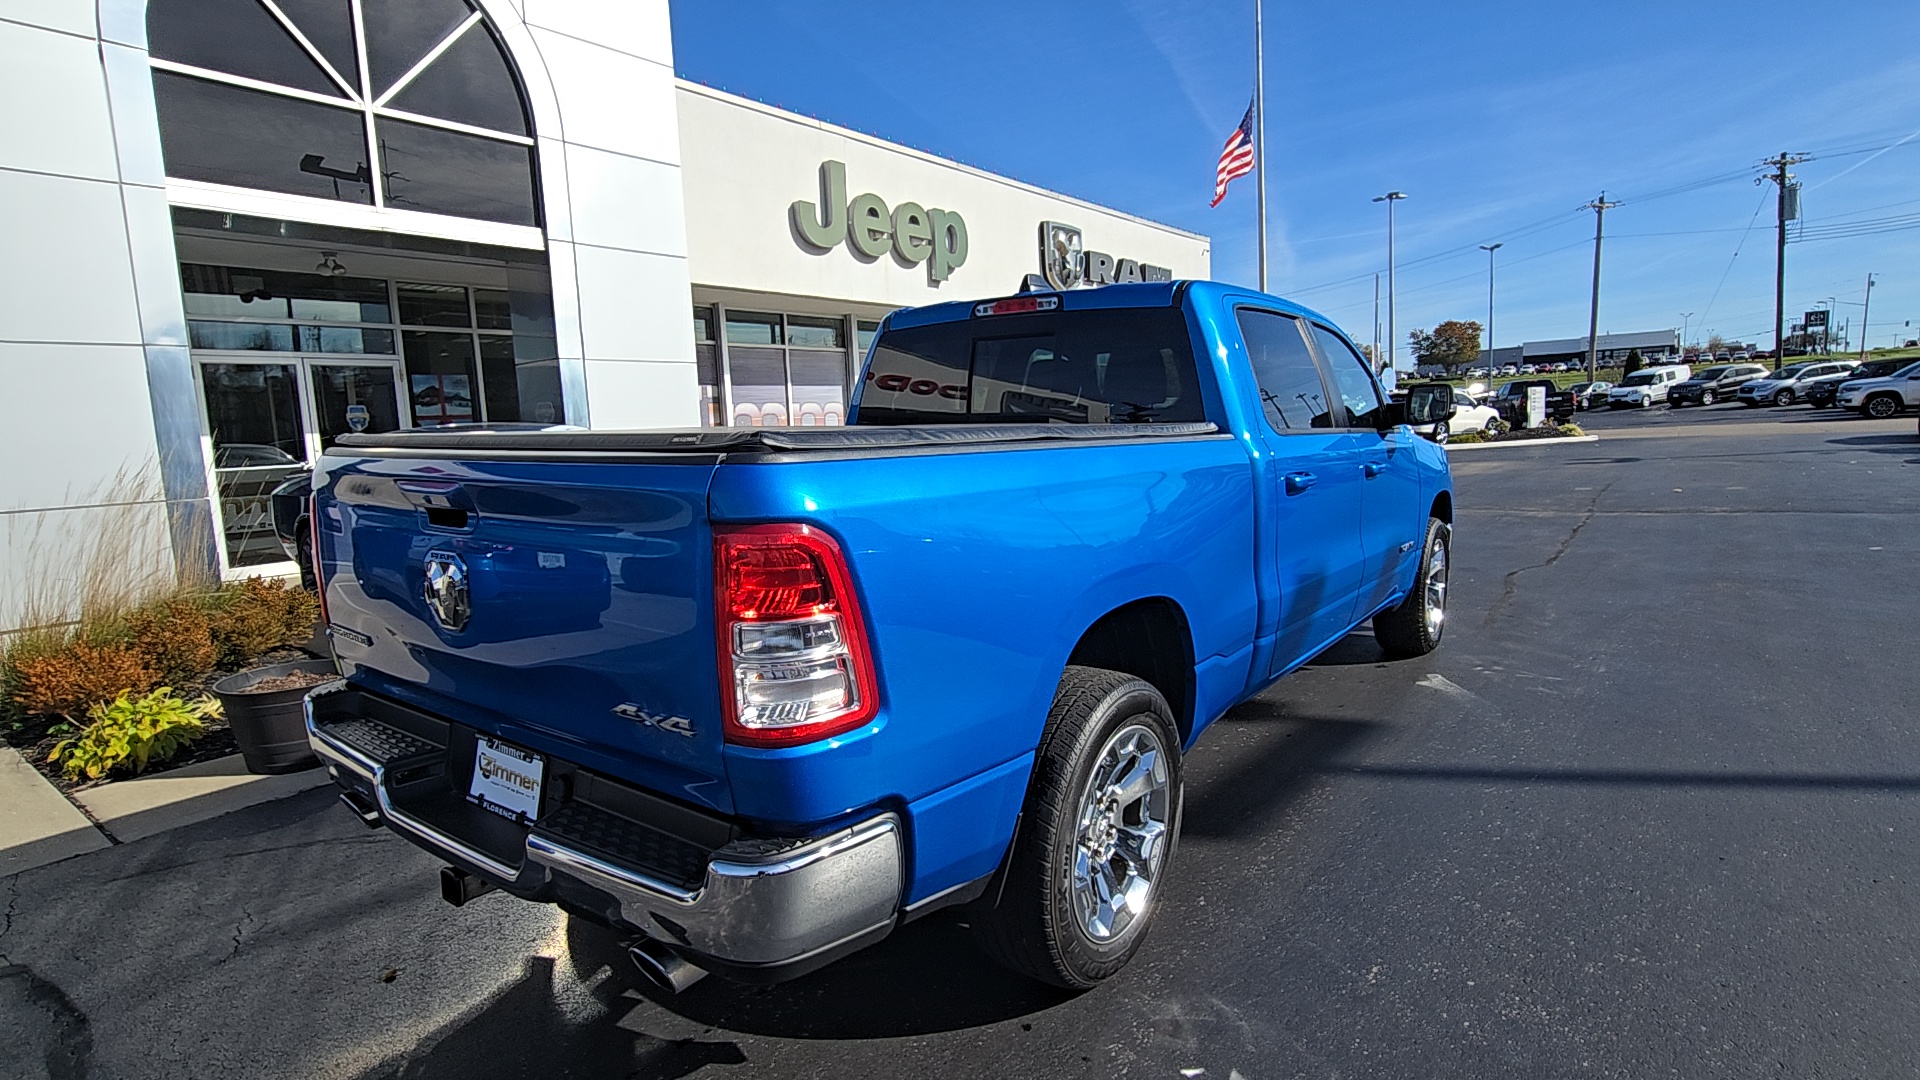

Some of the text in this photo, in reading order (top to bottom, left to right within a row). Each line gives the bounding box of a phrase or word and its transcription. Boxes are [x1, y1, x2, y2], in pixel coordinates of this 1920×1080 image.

[789, 160, 968, 287] Jeep
[1084, 250, 1172, 284] RAM
[492, 739, 526, 760] Zimmer
[481, 754, 539, 792] Zimmer
[482, 801, 518, 821] FLORENCE
